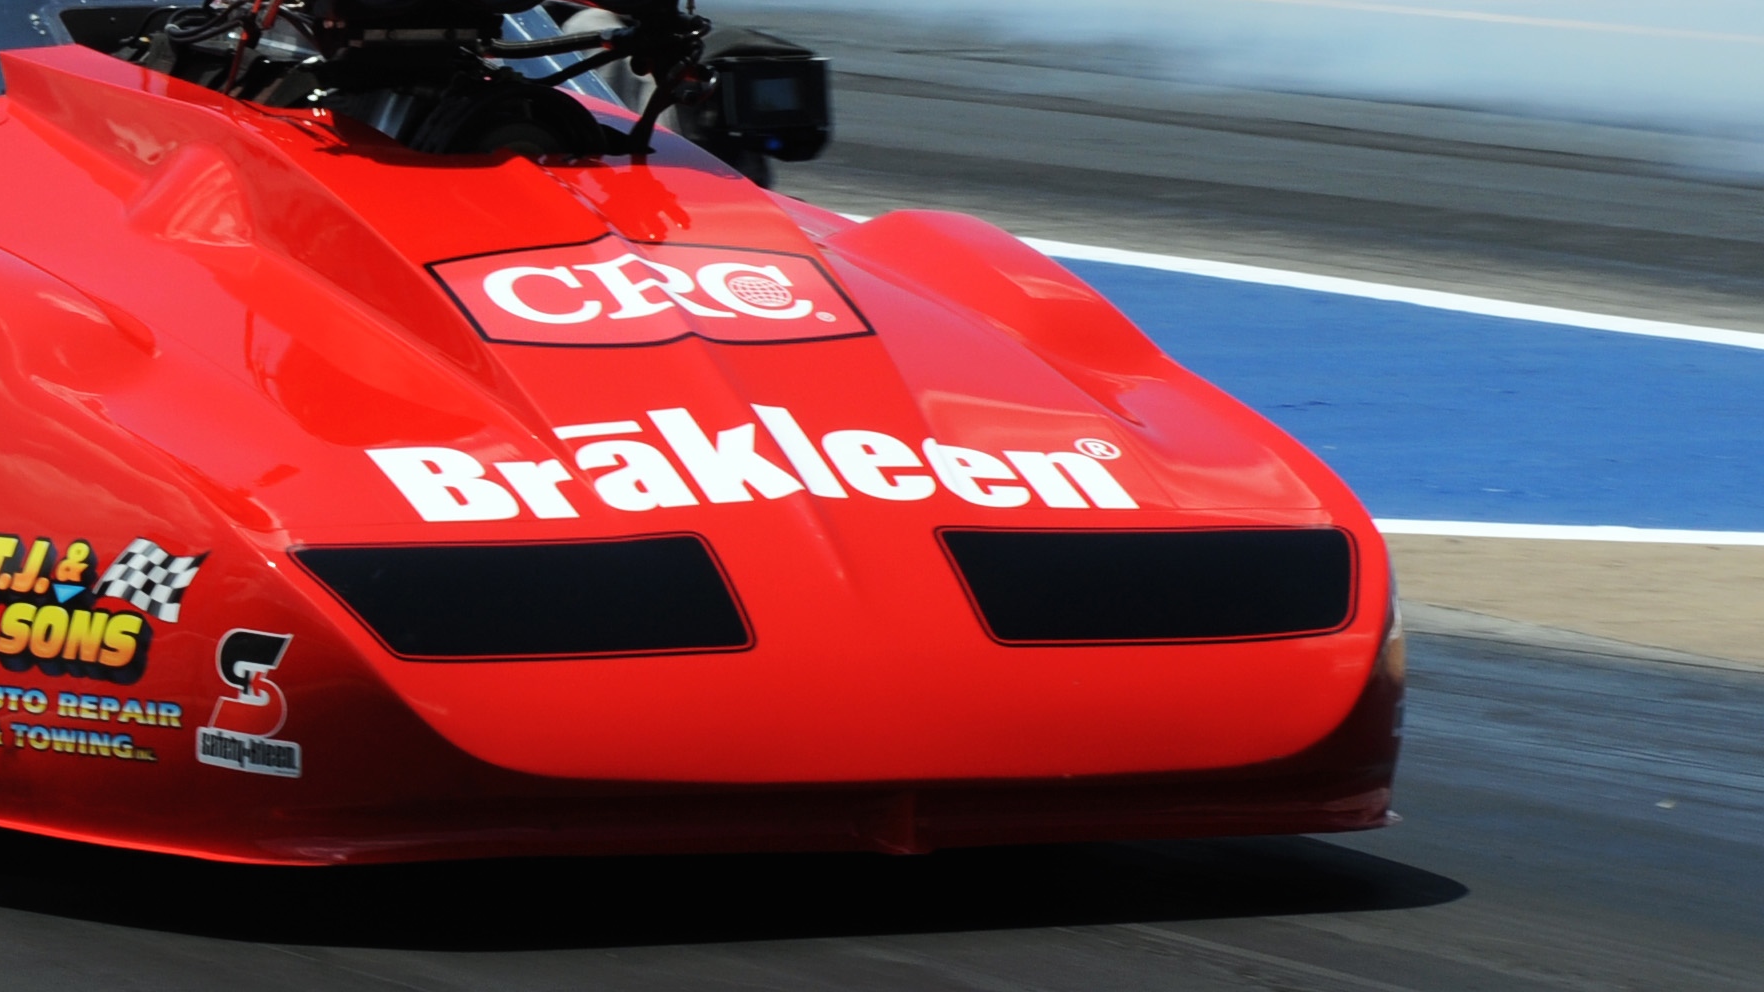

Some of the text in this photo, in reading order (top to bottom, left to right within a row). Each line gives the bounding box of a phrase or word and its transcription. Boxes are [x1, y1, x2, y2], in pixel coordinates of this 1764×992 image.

[482, 252, 814, 325] CRC
[57, 691, 184, 729] REPAIR
[9, 722, 135, 760] TOWING
